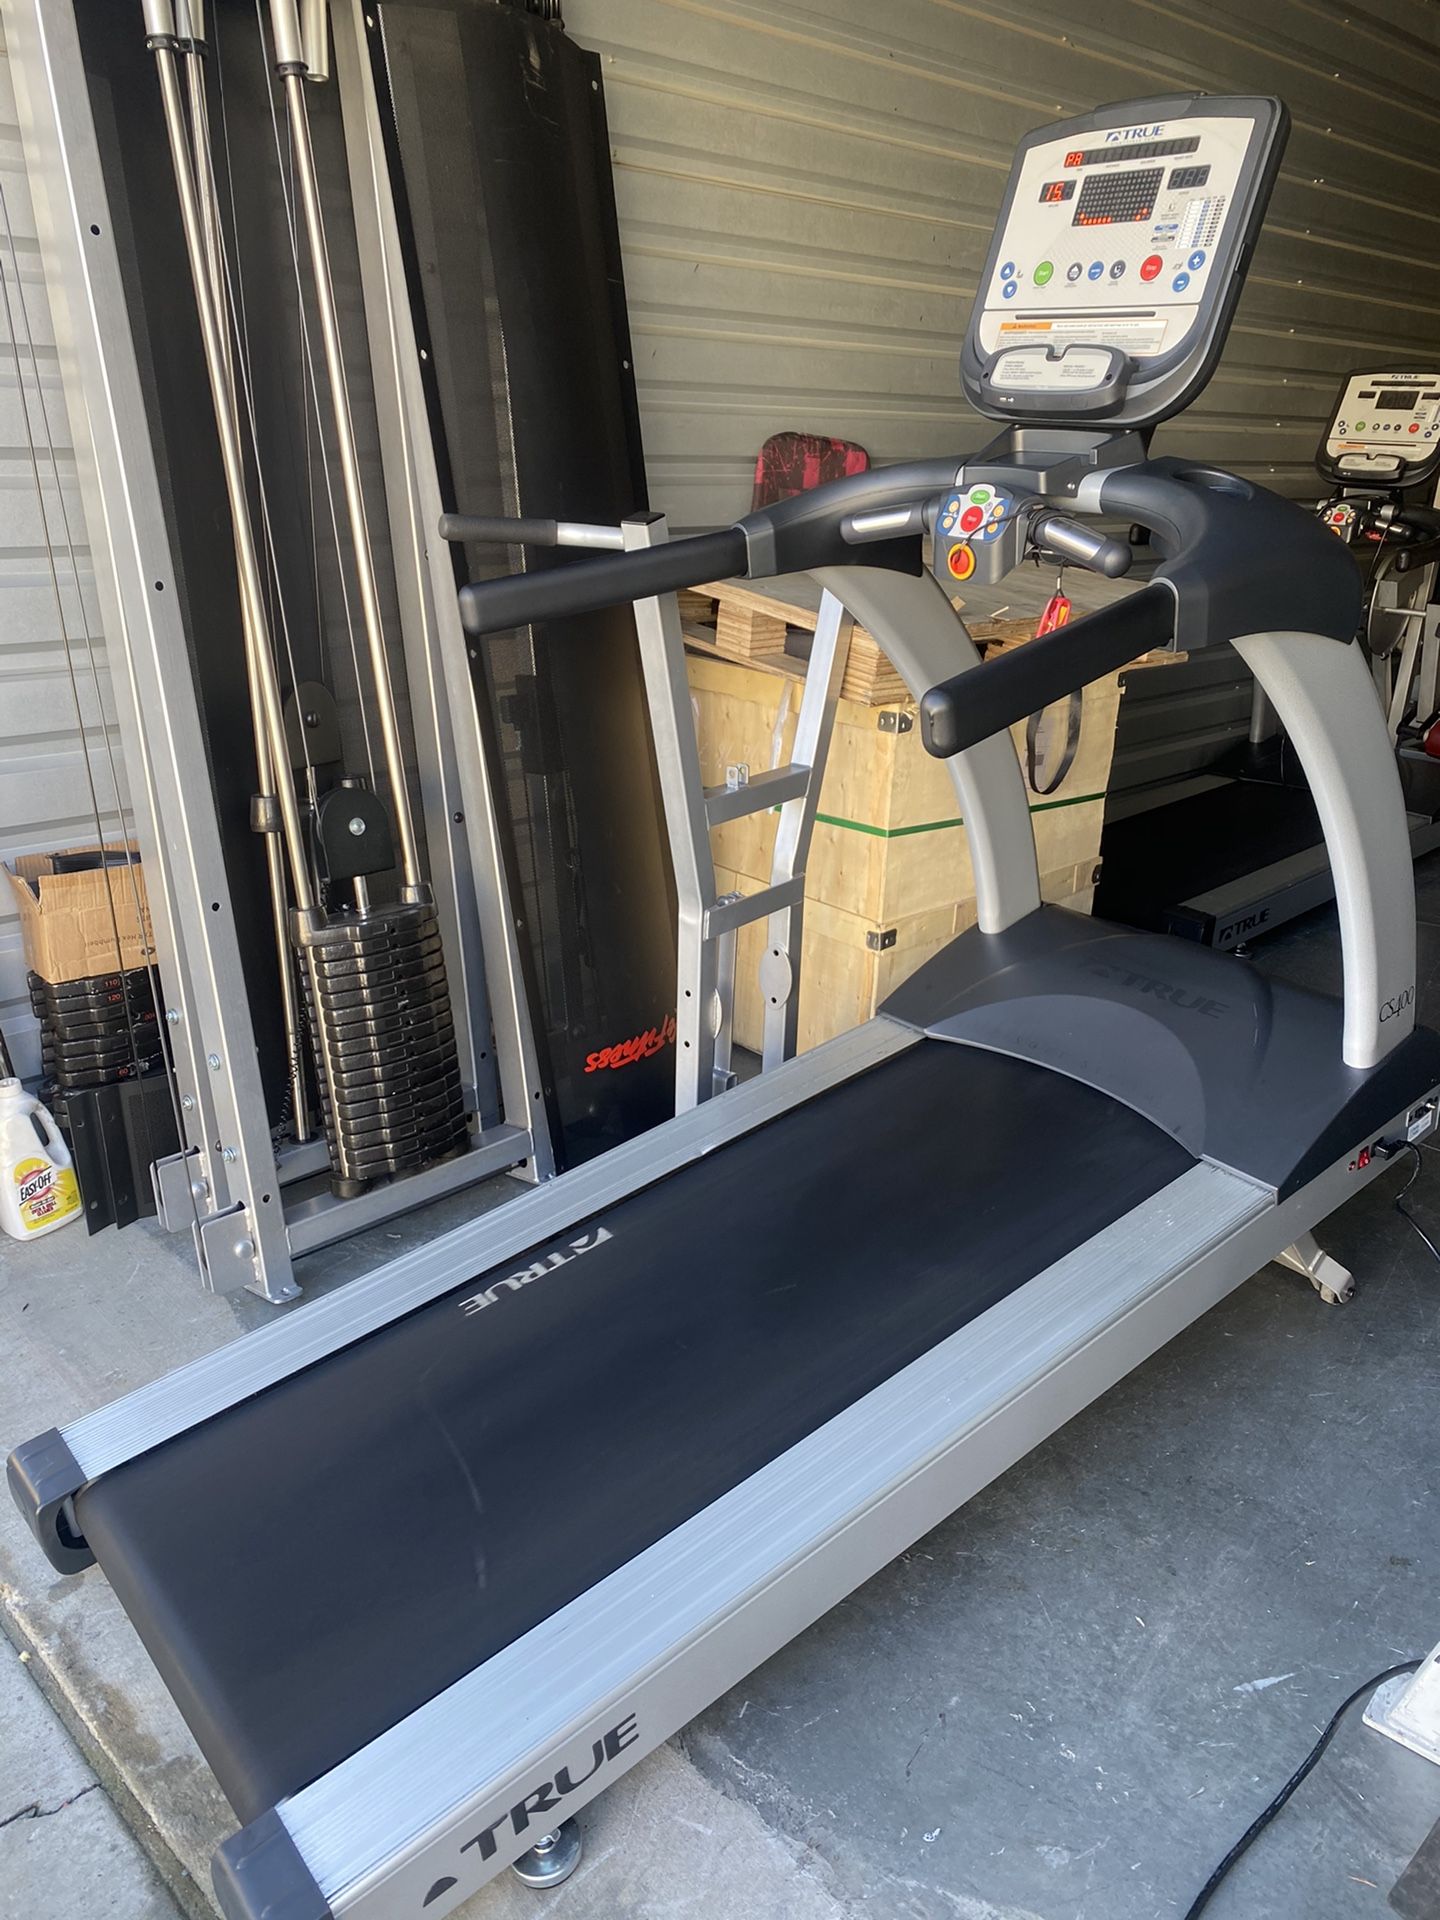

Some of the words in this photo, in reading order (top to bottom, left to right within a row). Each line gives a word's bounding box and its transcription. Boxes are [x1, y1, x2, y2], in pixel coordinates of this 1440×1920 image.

[1123, 125, 1166, 139] TRUE
[1234, 908, 1270, 936] TRUE
[105, 979, 118, 988] 110
[107, 993, 121, 1002] 120
[1121, 972, 1230, 1019] TRUE
[1379, 985, 1415, 1023] CS400
[584, 1013, 668, 1073] Fitness
[20, 1171, 52, 1201] EASY-OFF
[458, 1251, 576, 1316] TRUE
[460, 1712, 640, 1862] TRUE
